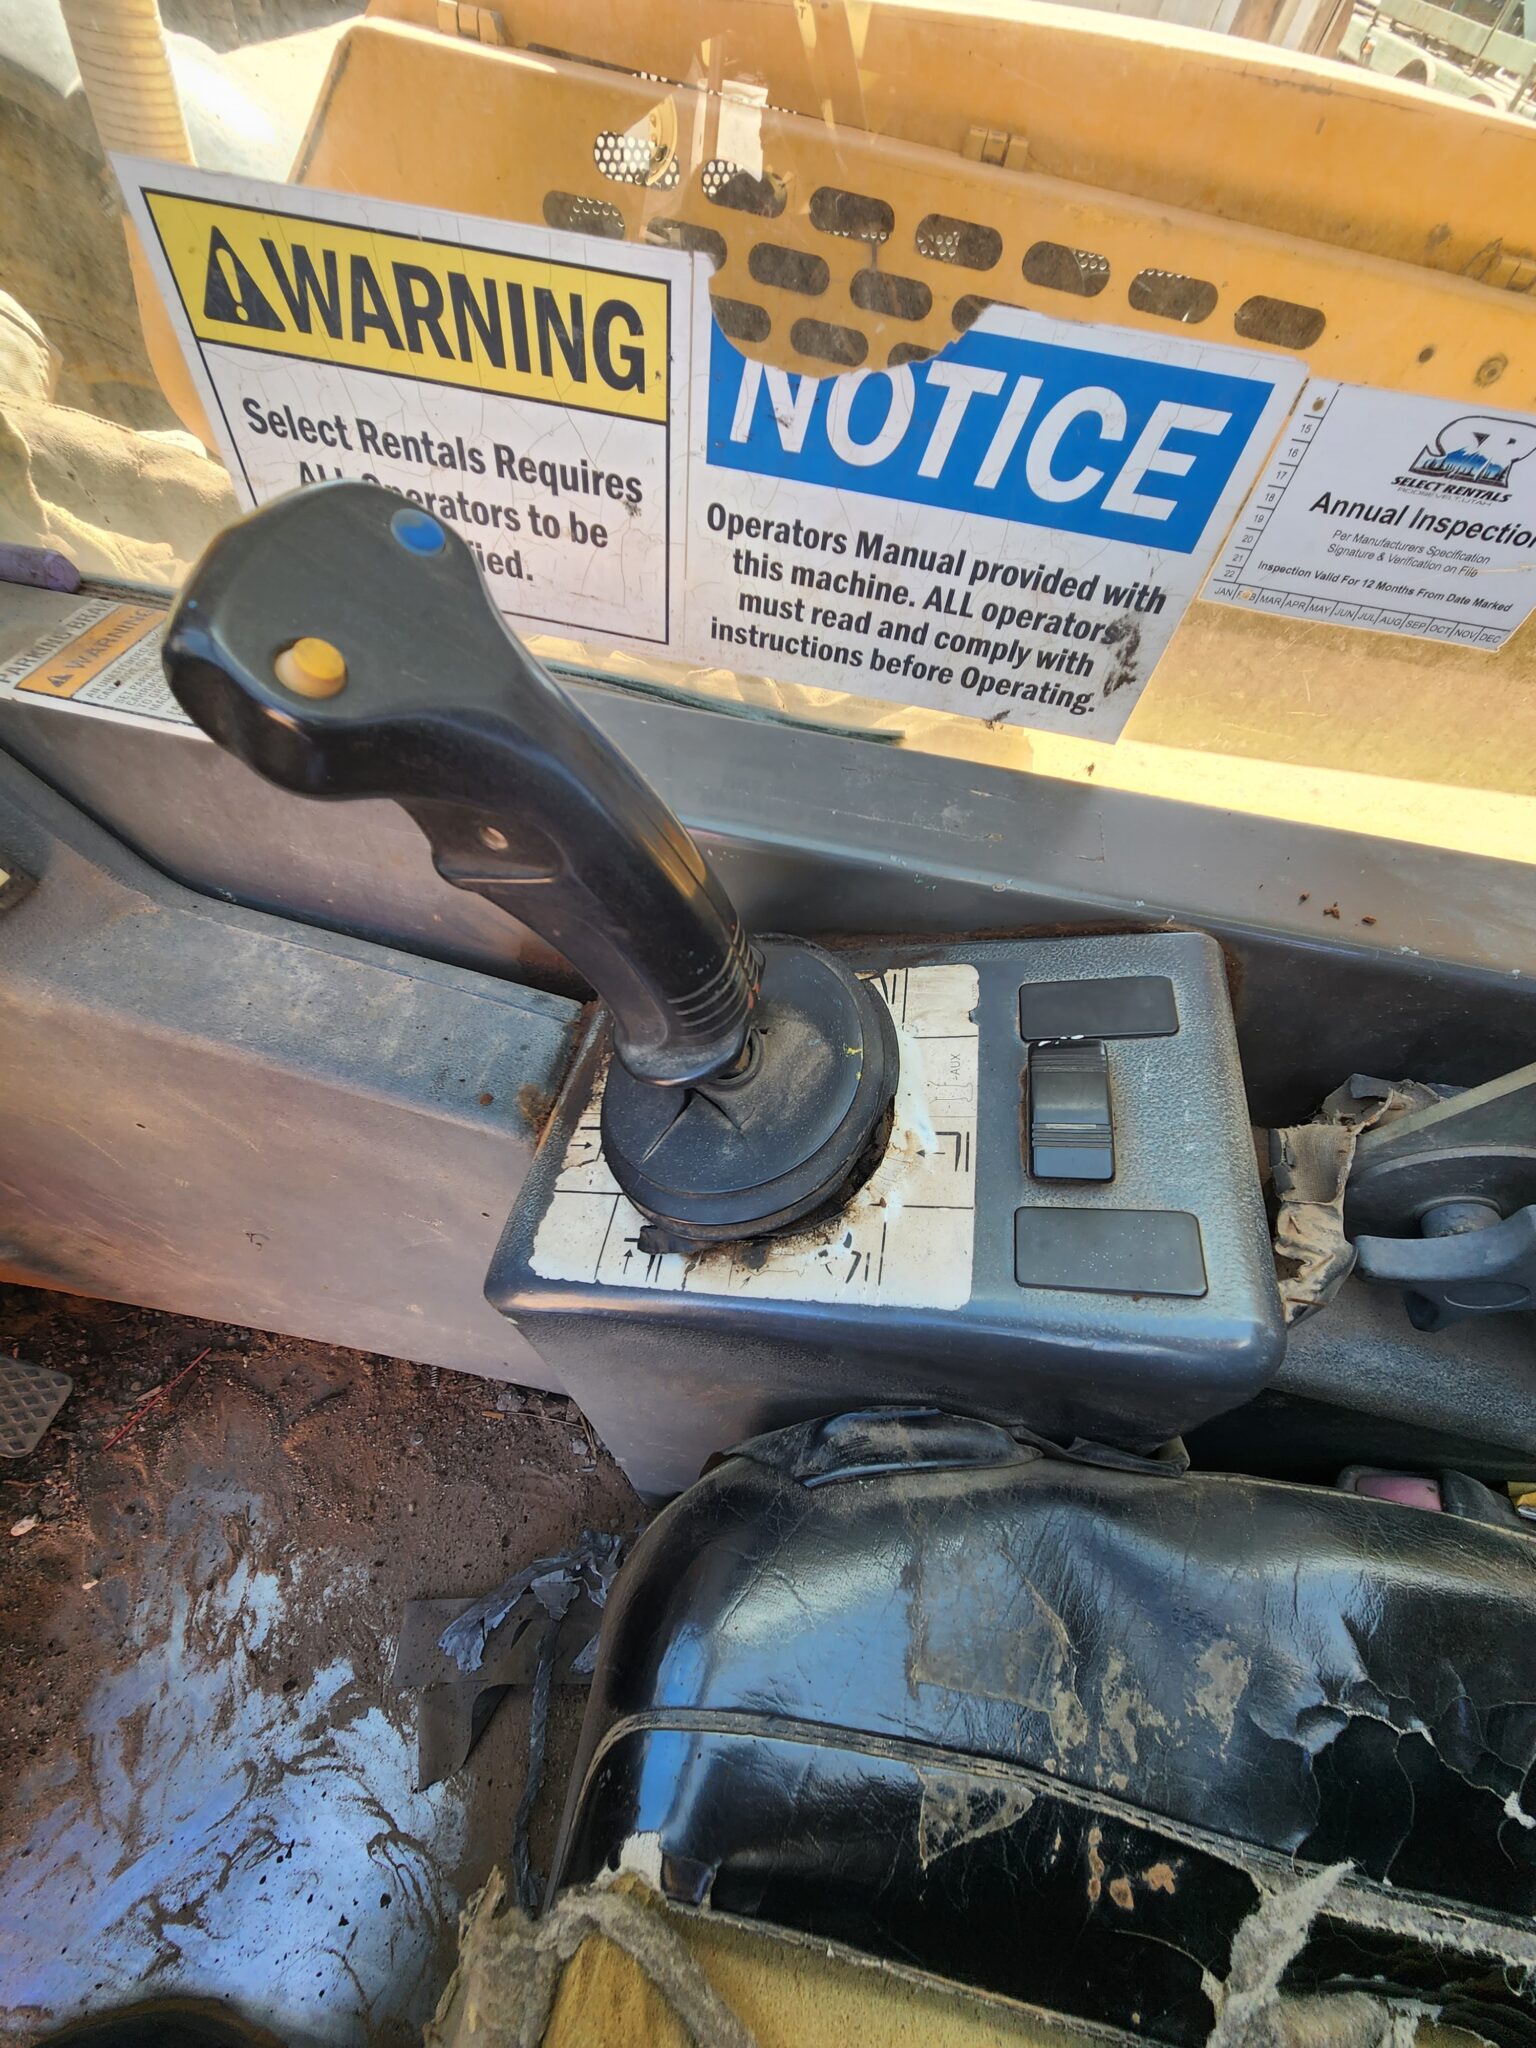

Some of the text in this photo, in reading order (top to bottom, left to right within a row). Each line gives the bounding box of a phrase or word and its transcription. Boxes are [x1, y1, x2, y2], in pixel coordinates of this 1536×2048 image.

[261, 238, 646, 394] WARNING
[729, 357, 1233, 521] NOTICE
[1299, 423, 1311, 435] 15
[242, 398, 352, 451] Select
[355, 419, 486, 476] Rentals
[494, 443, 643, 503] Requires
[1288, 447, 1298, 458] 16
[1276, 470, 1287, 480] 17
[1391, 476, 1512, 502] SELECT RENTALS
[1265, 492, 1275, 502] 18
[1310, 492, 1408, 526] Annual
[528, 505, 560, 539] to
[569, 511, 608, 548] be
[1254, 514, 1264, 524] 19
[707, 502, 1167, 615] Operators Manual provided with
[1232, 553, 1243, 562] 21
[1242, 534, 1253, 544] 20
[1332, 529, 1490, 565] Per Manufacturers Specification
[1224, 569, 1235, 578] 22
[1327, 543, 1478, 579] Signature & Verification on File
[732, 549, 1119, 646] this machine. ALL operators
[1258, 560, 1513, 612] Inspection Valid For 12 Months From Date Marked
[739, 591, 1095, 677] must read and comply with
[1214, 586, 1234, 597] JAN
[1259, 594, 1282, 606] MAR
[1285, 599, 1306, 610] APR
[1309, 604, 1332, 614] MAY
[1334, 608, 1356, 618] JUN
[1357, 611, 1375, 622] JUL
[1380, 615, 1401, 626] AUG
[1405, 620, 1426, 630] SEP
[1429, 624, 1451, 634] OCT
[1454, 629, 1478, 639] NOV
[1479, 633, 1501, 644] DEC
[0, 599, 117, 684] PARKING BRAK
[65, 609, 155, 669] WARNING
[711, 617, 1096, 714] instructions before Operating.
